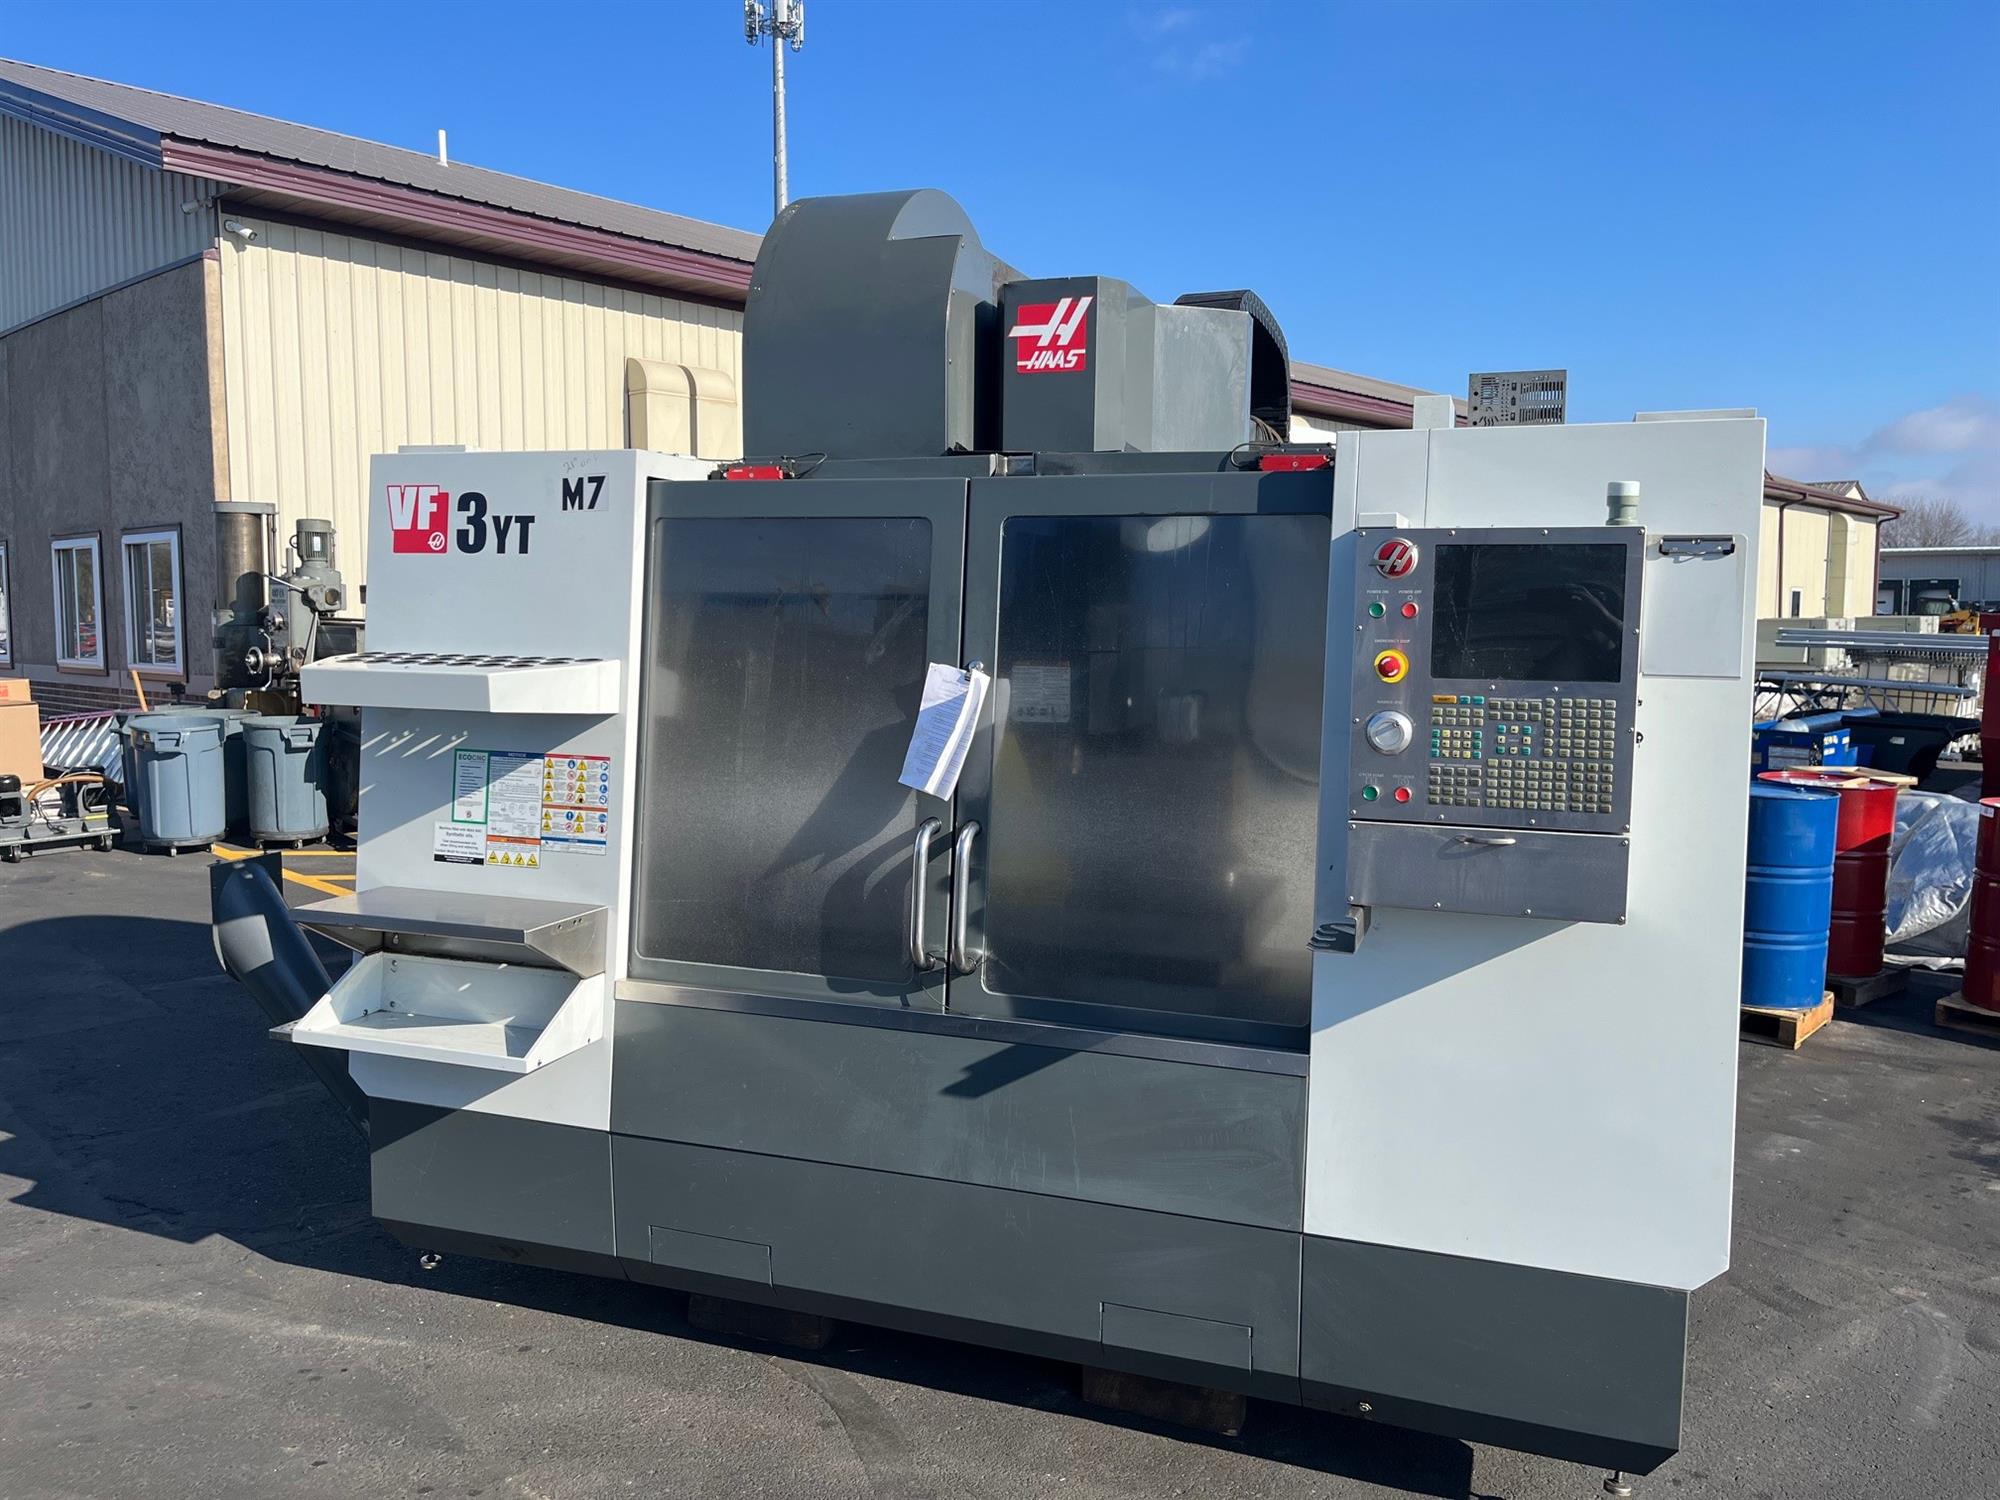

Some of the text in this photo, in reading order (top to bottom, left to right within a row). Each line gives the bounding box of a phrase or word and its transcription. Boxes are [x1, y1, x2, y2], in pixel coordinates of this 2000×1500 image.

[1017, 349, 1086, 370] HAAS
[387, 485, 440, 531] VF
[562, 475, 606, 511] M7
